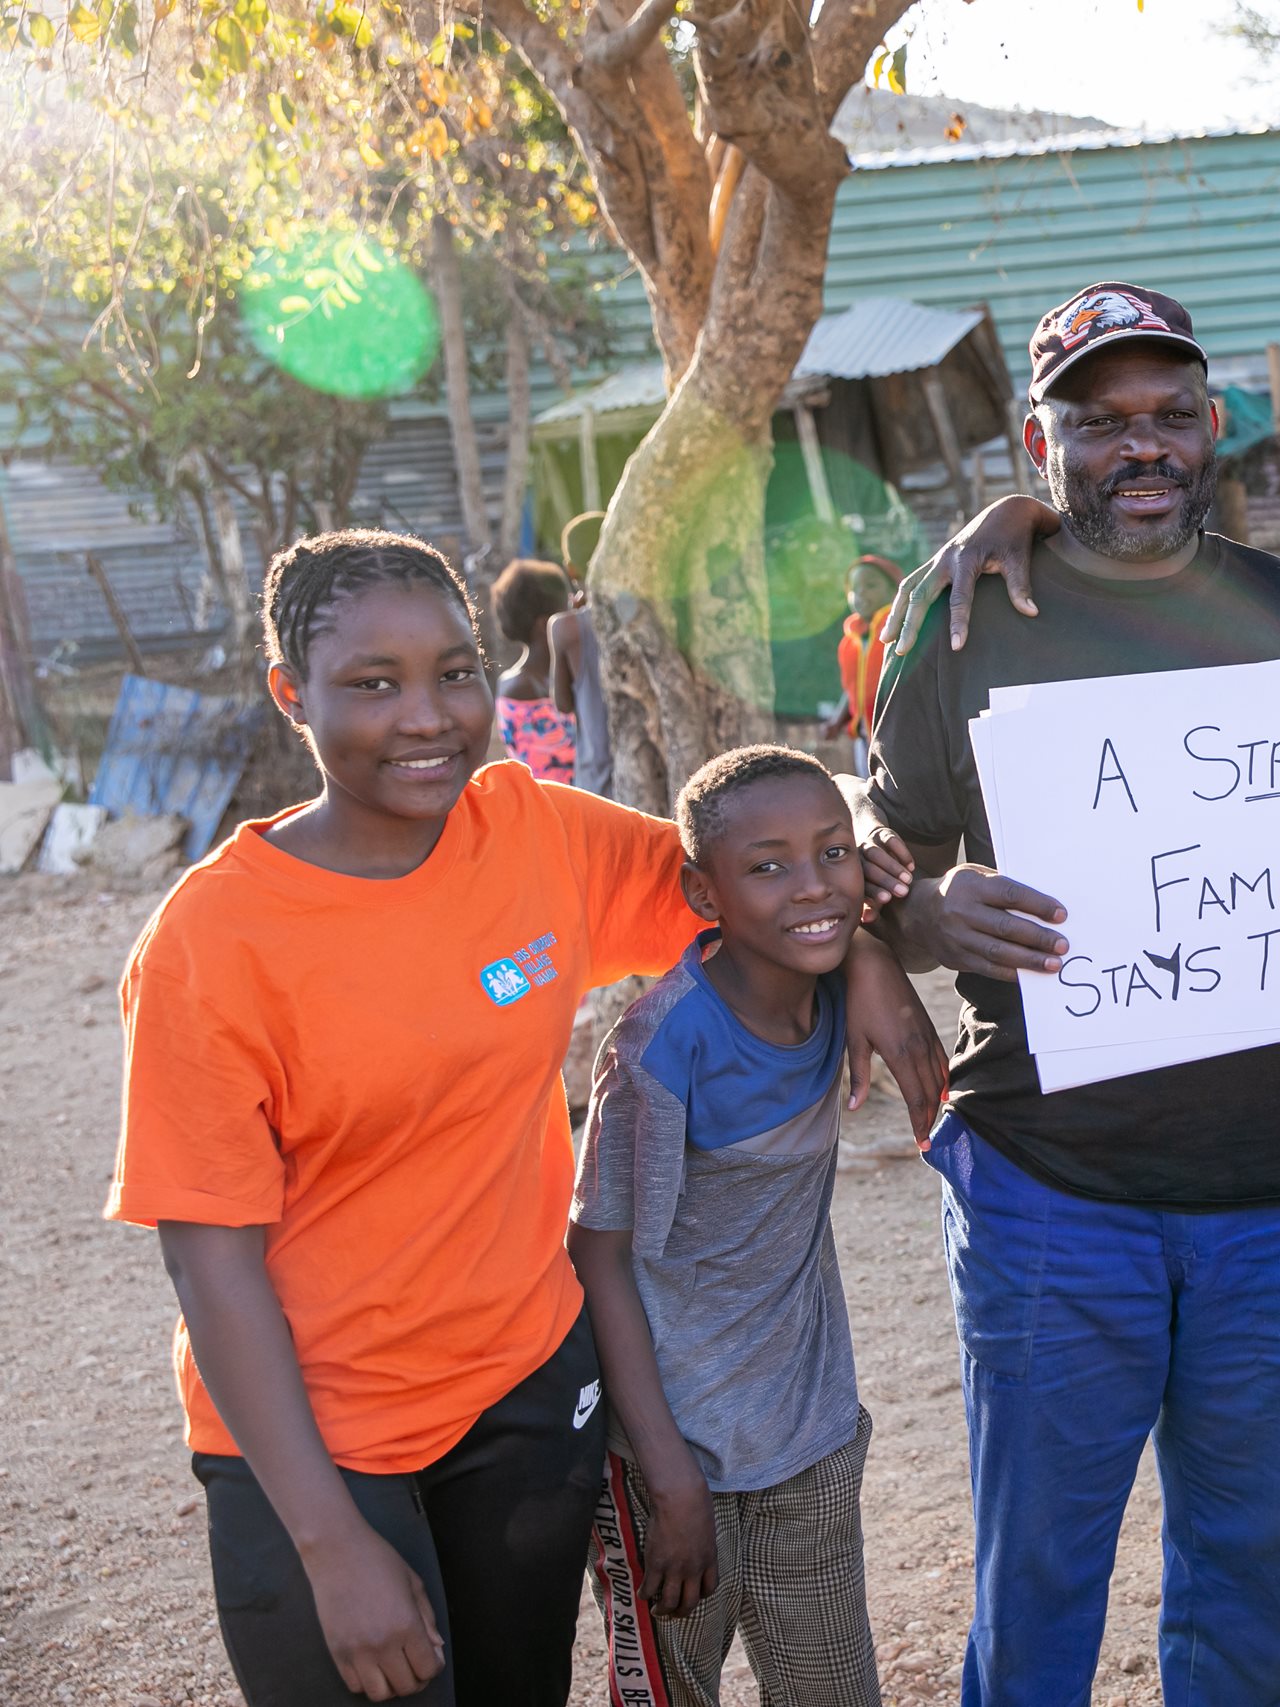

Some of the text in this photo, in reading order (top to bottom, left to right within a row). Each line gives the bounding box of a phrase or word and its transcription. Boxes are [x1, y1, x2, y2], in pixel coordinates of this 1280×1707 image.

[1092, 738, 1138, 813] A
[1058, 943, 1222, 1018] STAYS
[606, 1557, 633, 1608] YOUR
[613, 1610, 644, 1677] SKILLS
